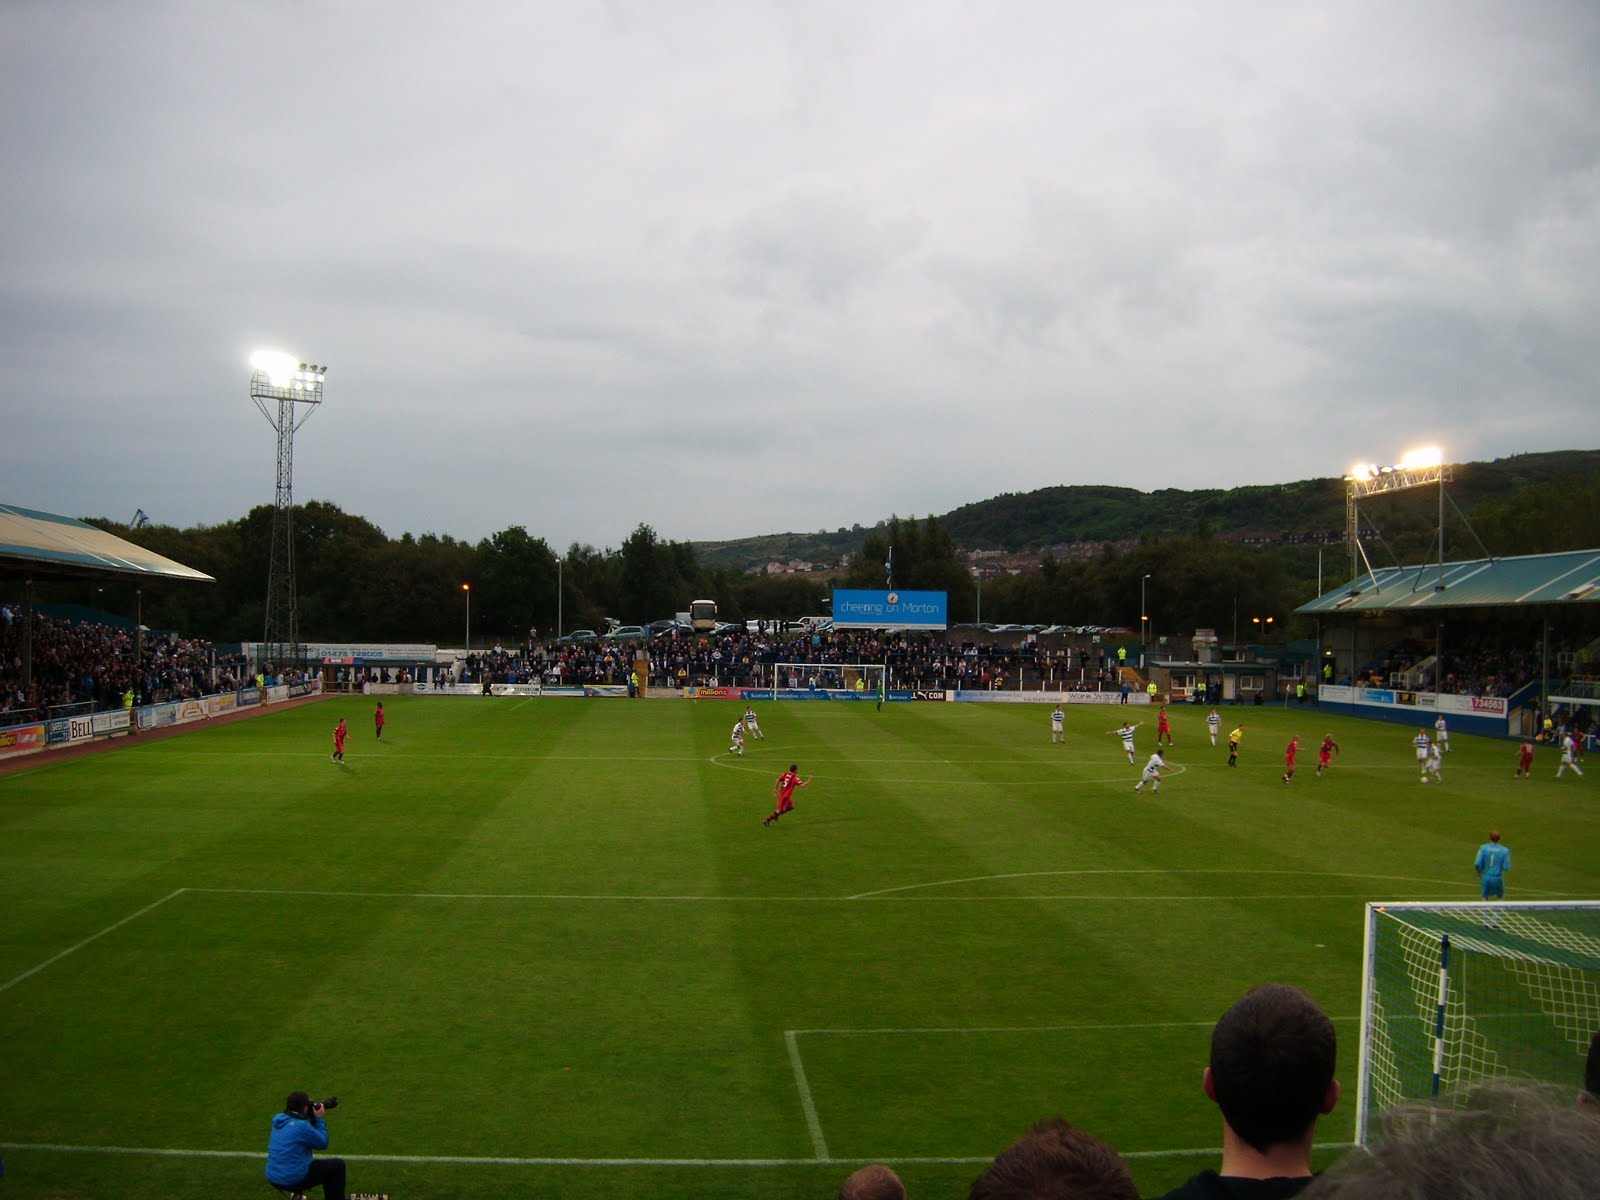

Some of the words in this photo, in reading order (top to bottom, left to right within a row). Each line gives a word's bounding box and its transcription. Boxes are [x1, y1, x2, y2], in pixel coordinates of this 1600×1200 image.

[841, 602, 883, 615] cheering
[887, 604, 899, 613] on
[903, 603, 939, 614] Morton
[1474, 698, 1503, 710] 734563
[1489, 854, 1495, 867] 1
